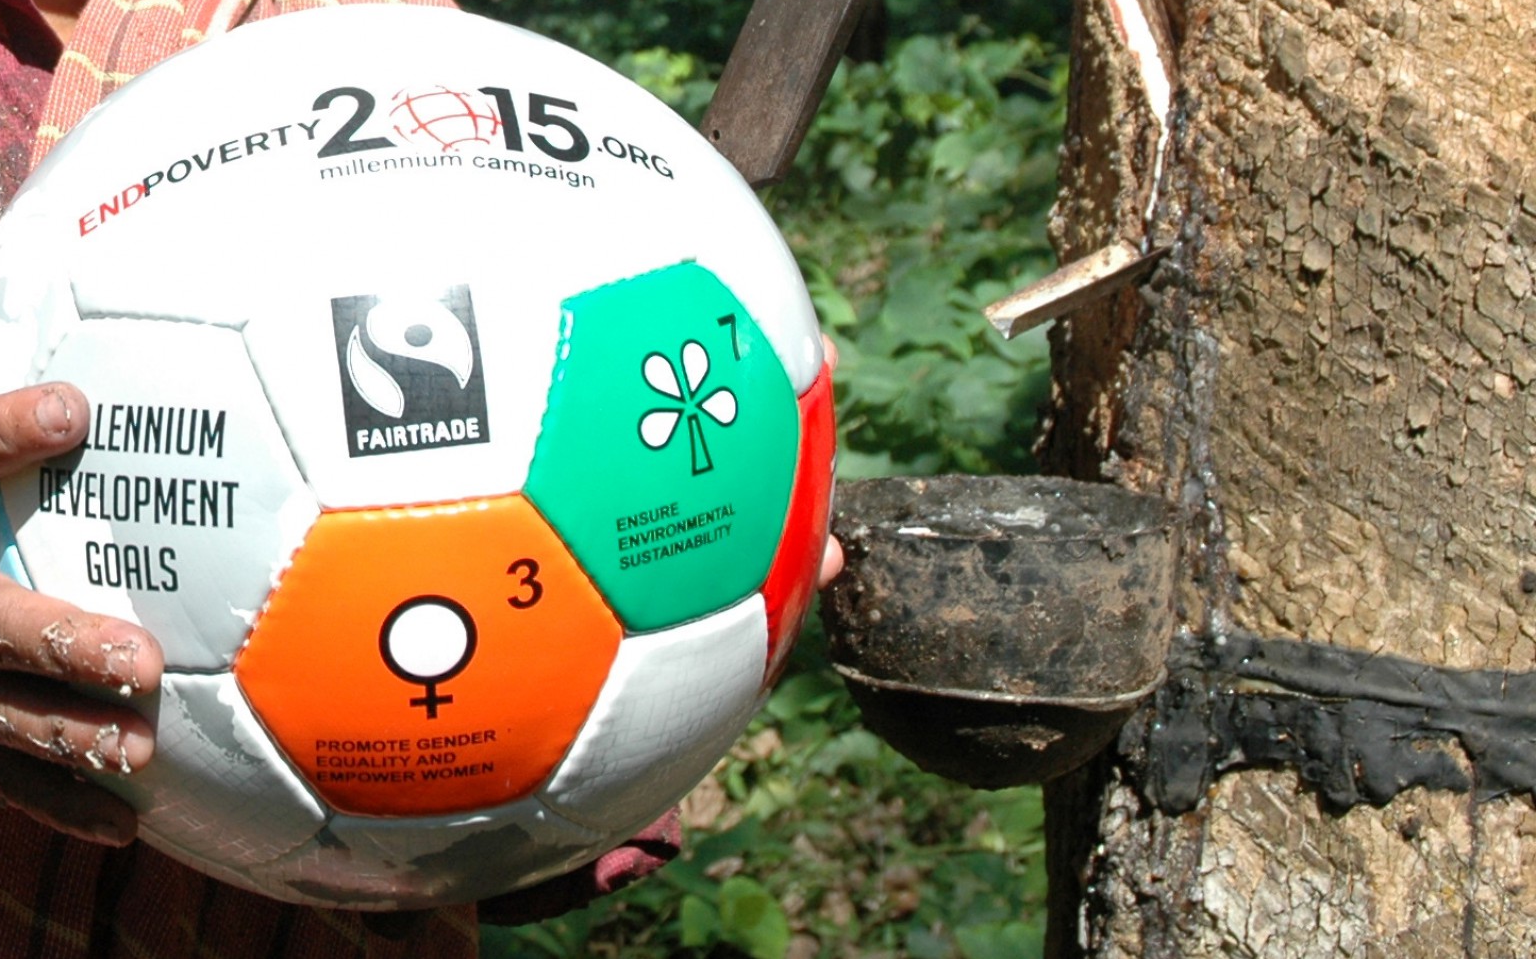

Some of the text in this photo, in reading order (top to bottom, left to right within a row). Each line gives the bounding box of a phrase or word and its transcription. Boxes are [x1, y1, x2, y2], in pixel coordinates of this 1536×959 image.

[320, 152, 595, 188] millennium campaign
[717, 314, 741, 361] 7
[82, 403, 226, 458] LENNIUM
[356, 417, 480, 450] FAIRTRADE
[39, 467, 239, 528] DEVELOPMENT
[617, 503, 679, 531] ENSURE
[617, 503, 736, 552] ENVIRONMENTAL
[618, 523, 733, 570] SUSTAINABILITY
[86, 541, 178, 592] GOALS
[506, 558, 544, 609] 3
[315, 729, 496, 753] PROMOTE GENDER
[316, 752, 456, 768] EQUALITY AND
[316, 763, 494, 783] EMPOWER WOMEN
